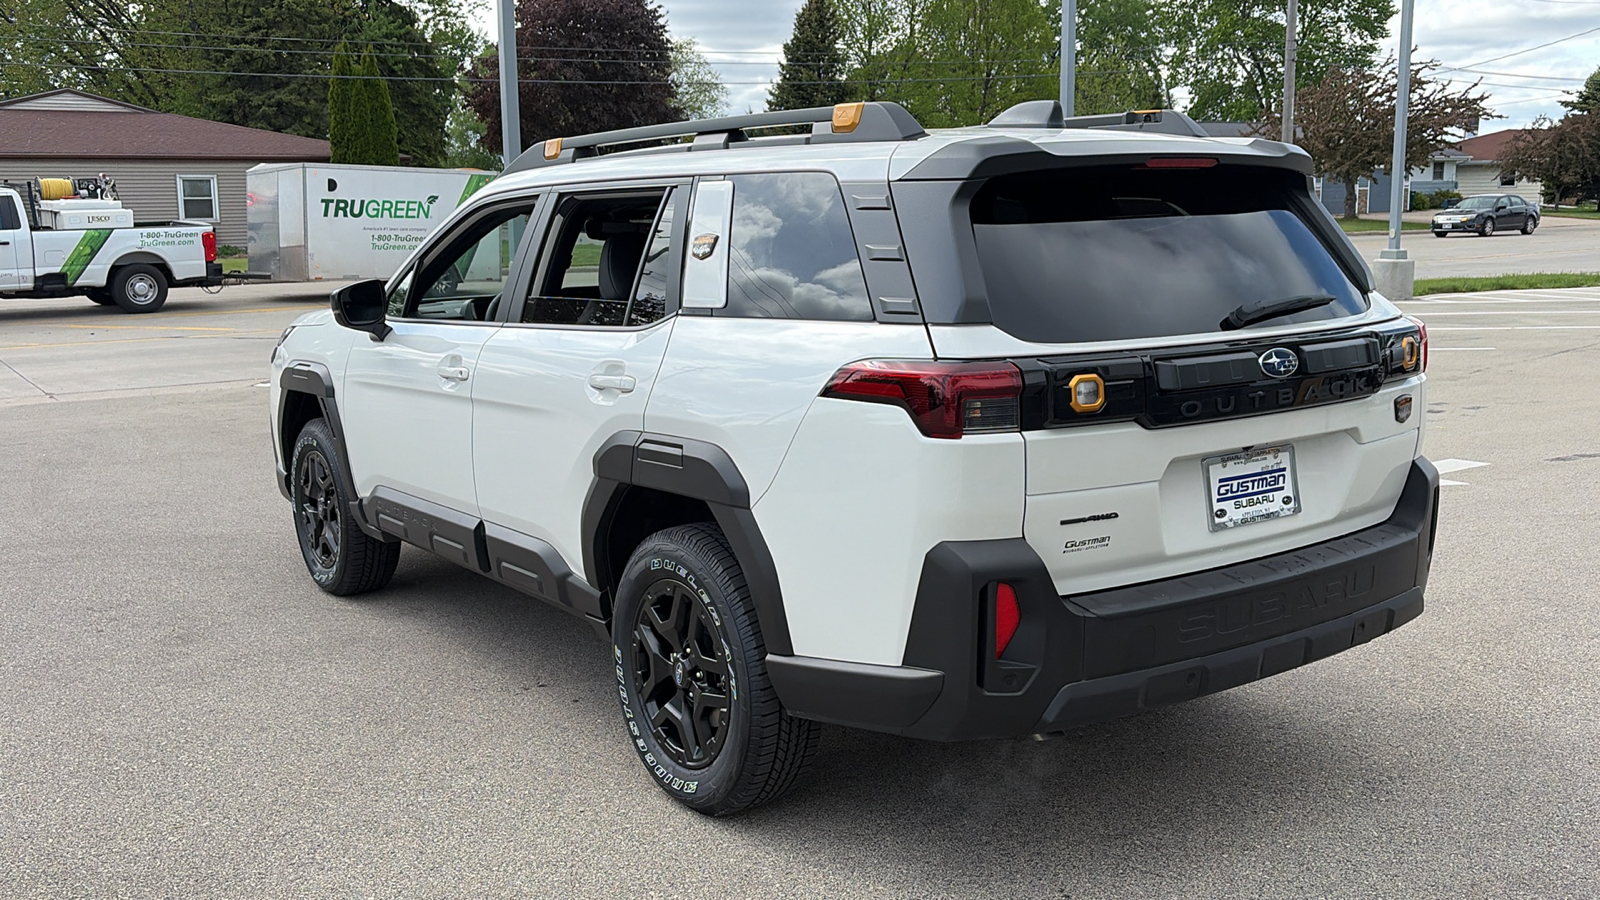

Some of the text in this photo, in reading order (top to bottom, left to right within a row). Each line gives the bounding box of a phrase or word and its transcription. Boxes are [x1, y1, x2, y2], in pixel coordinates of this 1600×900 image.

[320, 198, 431, 219] TRUGREEN
[87, 215, 110, 224] LESCO
[140, 231, 199, 239] 1-800-TruGreen
[140, 239, 195, 247] TruGreen.com
[371, 242, 418, 251] TruGreen.co
[1180, 376, 1369, 418] OUTBACK
[1233, 494, 1275, 510] SUBARU
[376, 500, 438, 532] OUTBACK
[651, 557, 721, 627] DUELER
[1178, 564, 1376, 644] SUBARU
[614, 644, 699, 794] BRIDGESTONE
